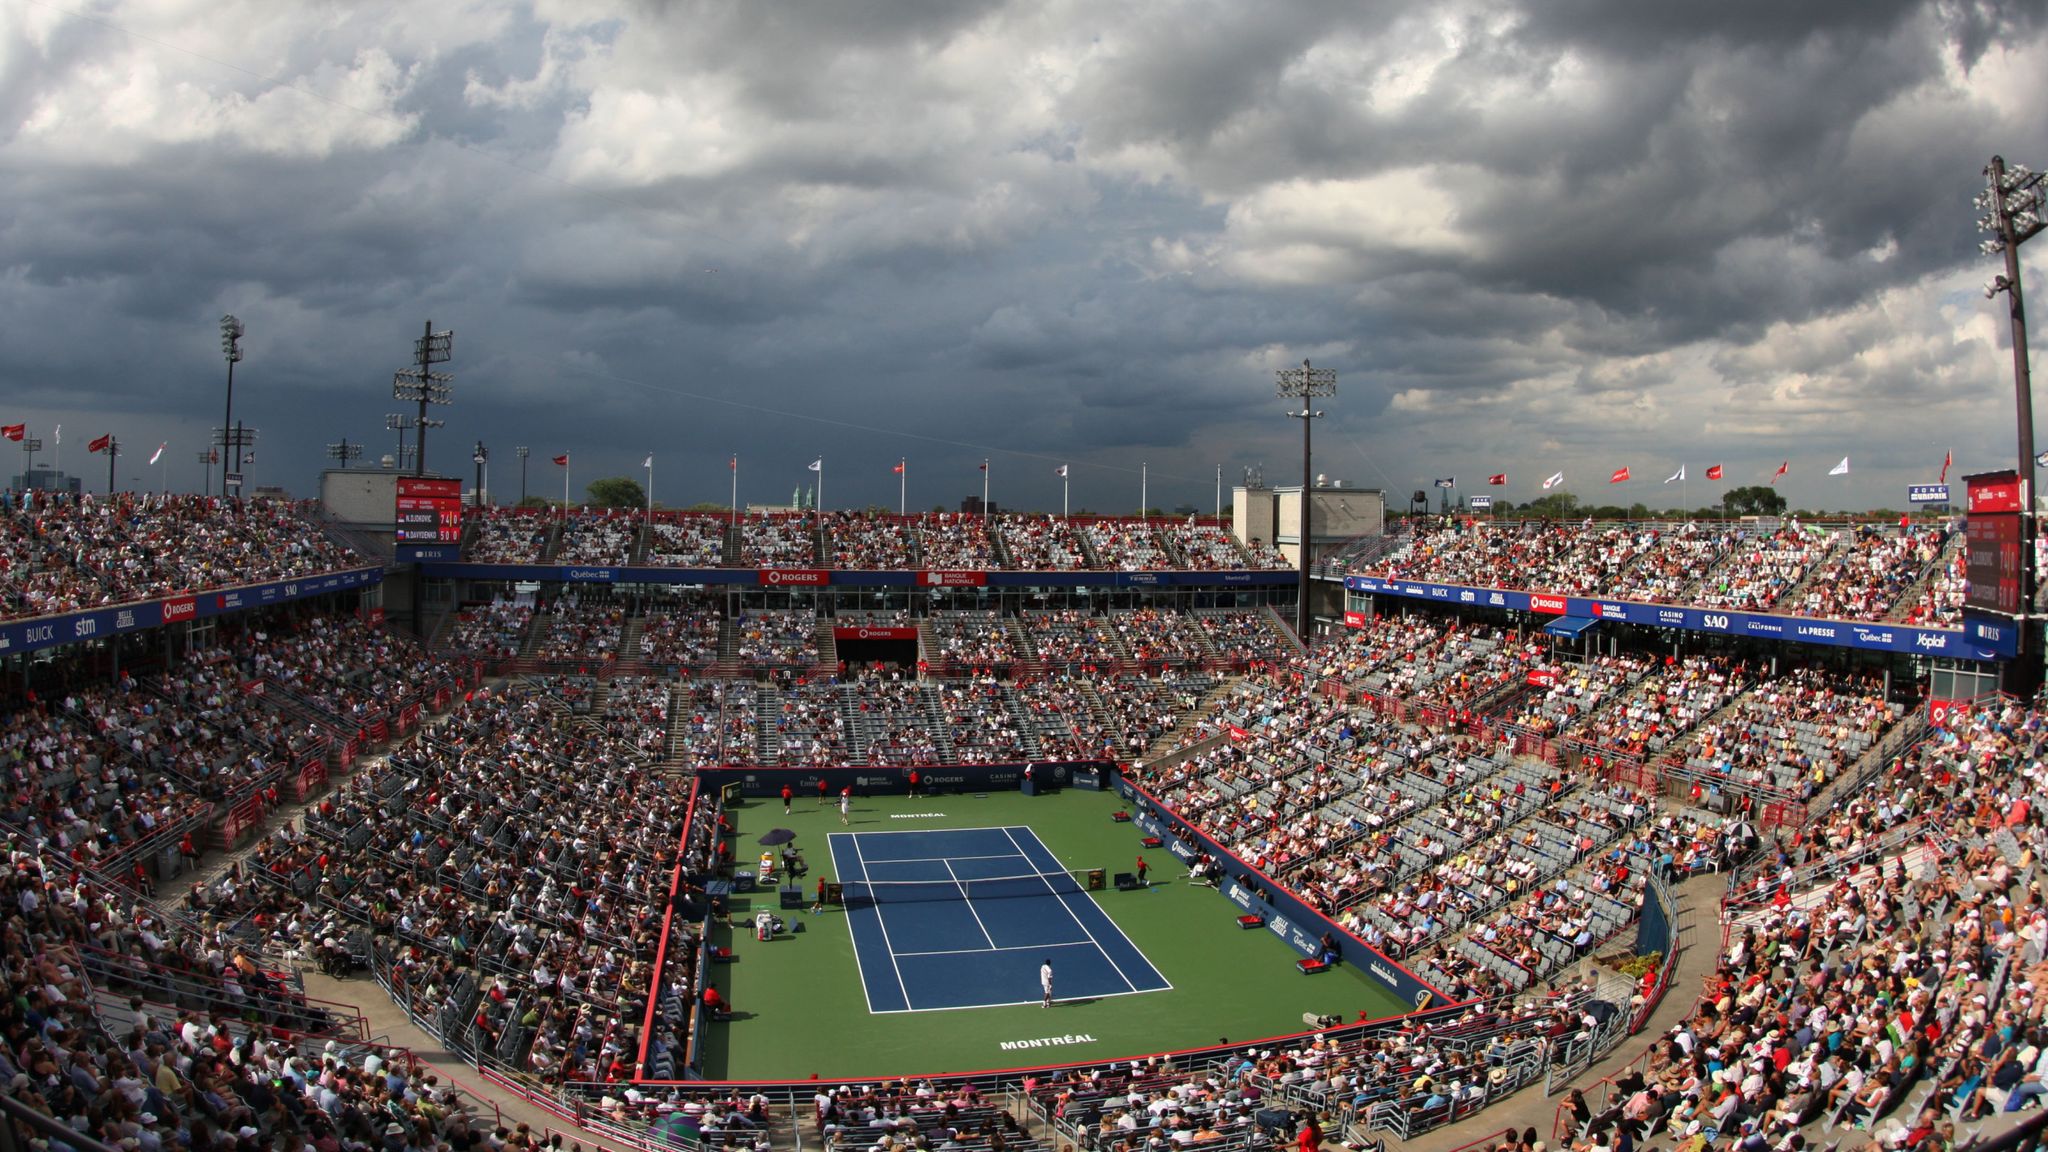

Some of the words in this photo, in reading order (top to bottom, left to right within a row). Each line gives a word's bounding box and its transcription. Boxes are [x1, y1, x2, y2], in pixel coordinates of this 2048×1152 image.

[571, 570, 598, 579] Québec
[782, 573, 818, 581] ROGERS
[285, 583, 298, 597] SAQ
[1432, 587, 1449, 598] BUICK
[1461, 590, 1475, 602] stm
[172, 602, 195, 614] ROGERS
[1538, 599, 1564, 609] ROGERS
[1602, 604, 1621, 612] BANQUE
[1602, 611, 1627, 619] NATIONALE
[1659, 610, 1684, 619] CASINO
[75, 616, 96, 636] stm
[1703, 614, 1729, 629] SAQ
[26, 624, 54, 644] BUICK
[1798, 626, 1808, 634] LA
[1808, 627, 1835, 637] PRESSE
[1860, 632, 1882, 642] Québec
[1984, 626, 2000, 641] IRIS
[934, 776, 964, 784] ROGERS
[1000, 1034, 1097, 1050] MONTRÉAL
